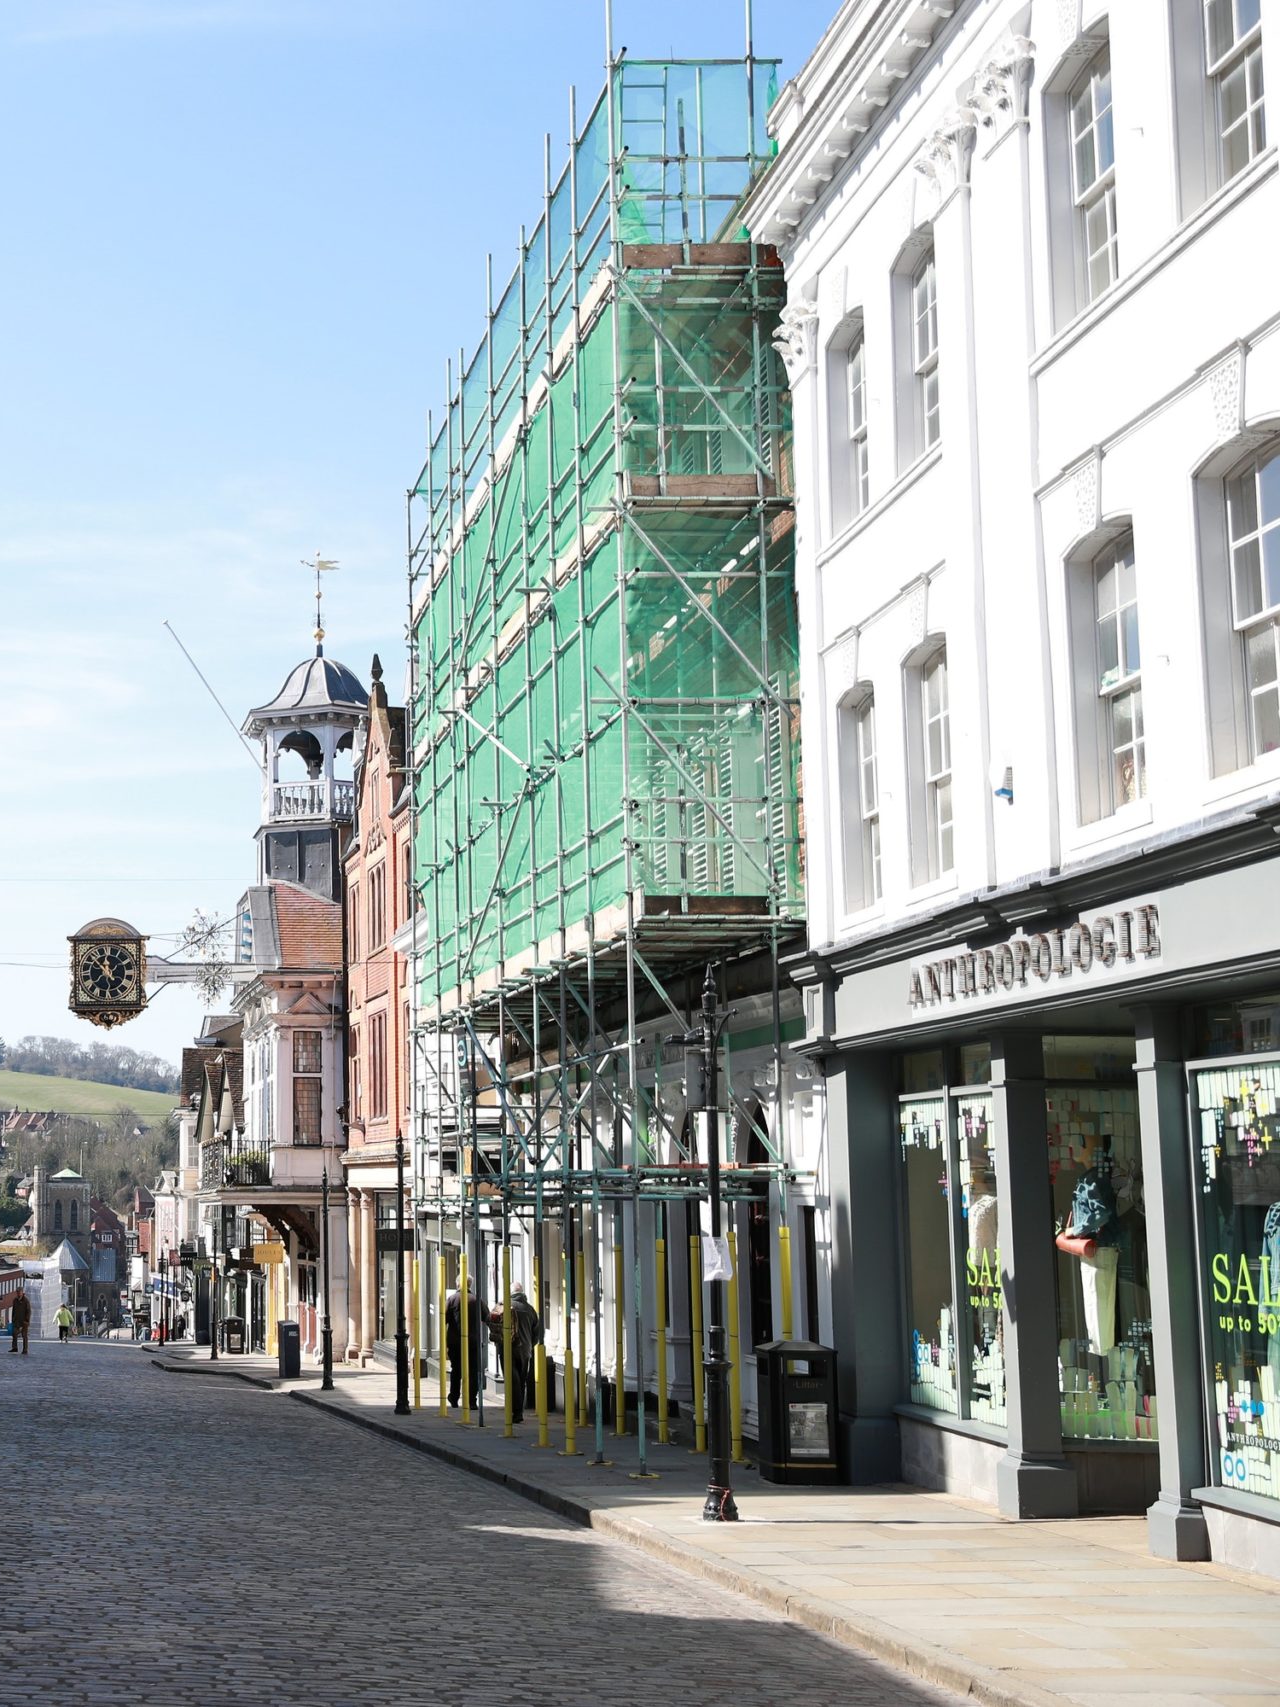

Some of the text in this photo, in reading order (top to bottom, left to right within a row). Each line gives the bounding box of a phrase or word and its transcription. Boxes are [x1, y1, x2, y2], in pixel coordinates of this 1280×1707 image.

[907, 904, 1162, 1008] ANTHROPOLOGIE
[969, 1295, 980, 1308] up
[981, 1295, 990, 1308] to
[1219, 1312, 1280, 1335] up to 50
[1227, 1431, 1280, 1451] ANTHROPOLOG
